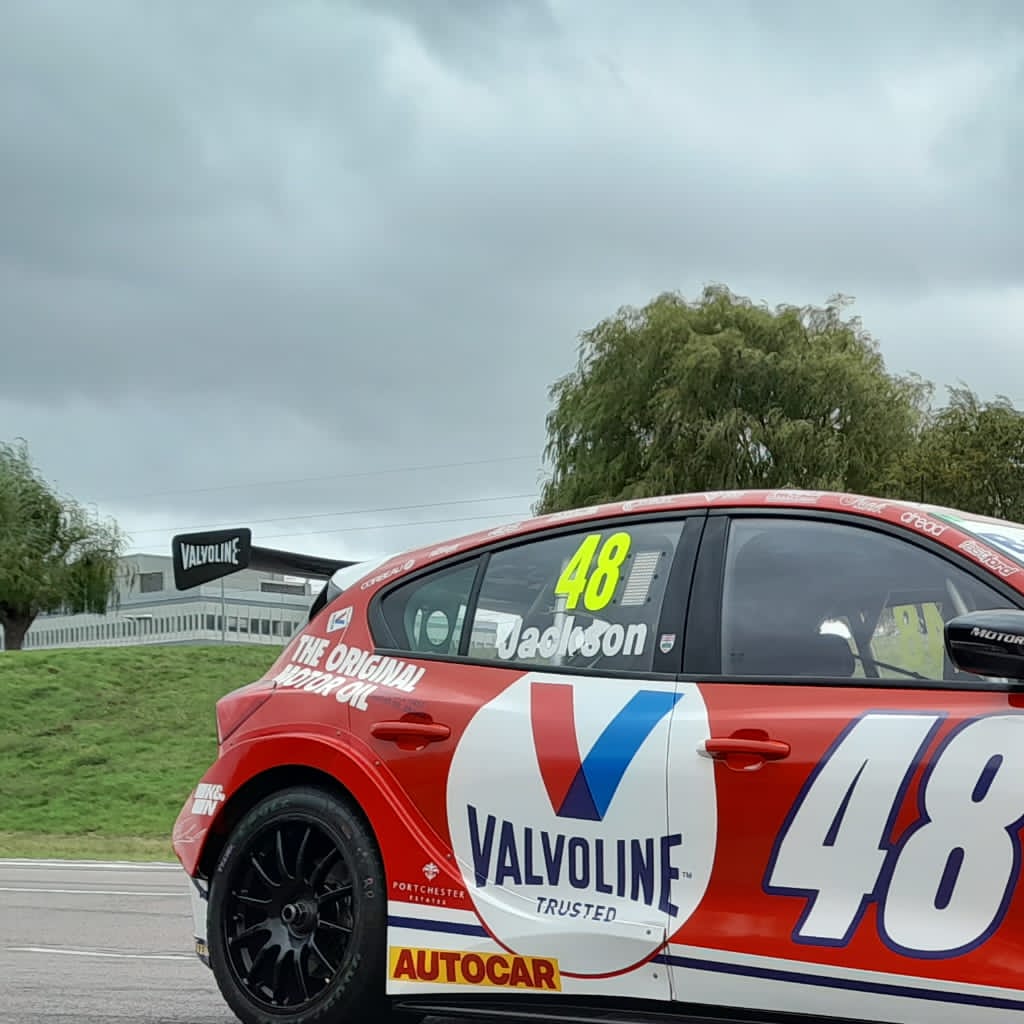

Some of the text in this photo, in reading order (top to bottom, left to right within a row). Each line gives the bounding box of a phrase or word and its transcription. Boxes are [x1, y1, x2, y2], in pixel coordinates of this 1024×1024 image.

[180, 537, 240, 570] VALVOLINE
[554, 532, 632, 611] 48
[495, 615, 648, 660] Jackson
[291, 634, 426, 692] THE ORIGINAL
[271, 663, 337, 697] MOTOR
[335, 681, 378, 711] OIL
[466, 803, 683, 918] VALVOLINE
[392, 881, 465, 899] PORTCHESTER
[536, 896, 617, 922] TRUSTED
[393, 948, 557, 990] AUTOCAR
